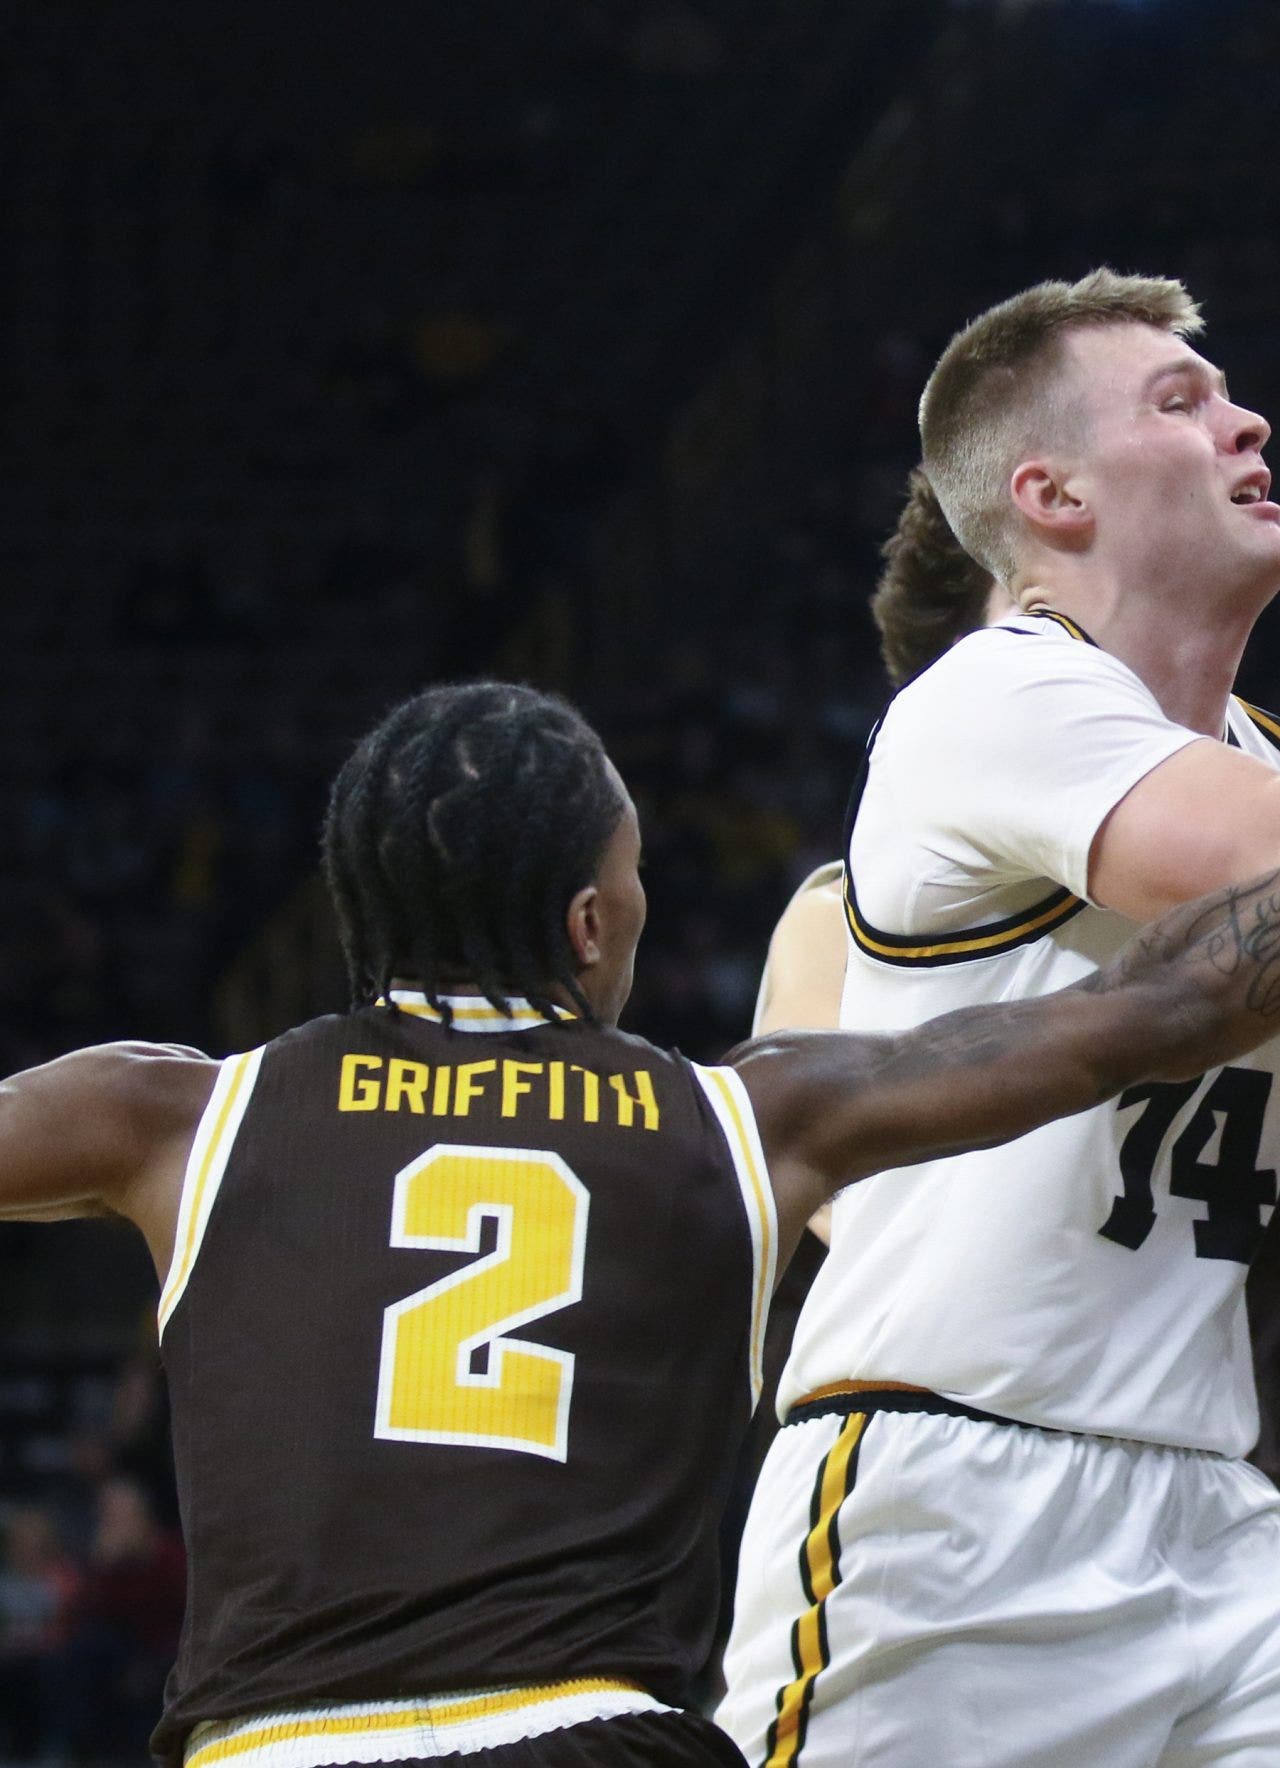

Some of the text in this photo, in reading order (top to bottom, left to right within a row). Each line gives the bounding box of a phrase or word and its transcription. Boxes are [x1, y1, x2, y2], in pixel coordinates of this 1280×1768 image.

[338, 1053, 659, 1132] GRIFFITH
[1098, 1066, 1278, 1265] 14
[374, 1143, 591, 1464] 2
